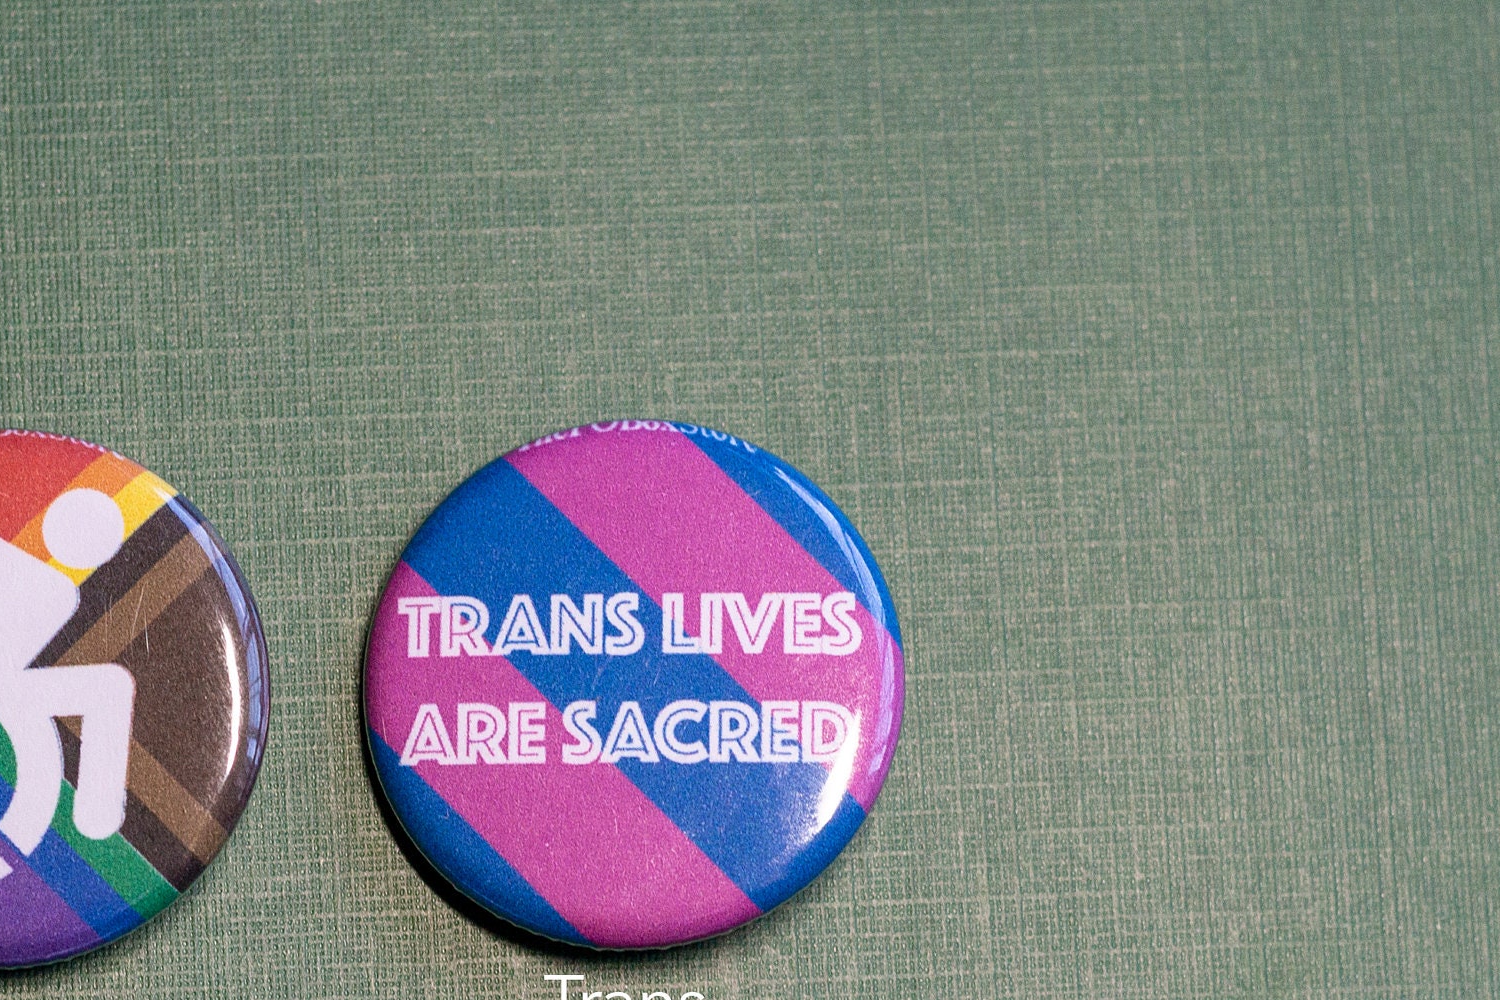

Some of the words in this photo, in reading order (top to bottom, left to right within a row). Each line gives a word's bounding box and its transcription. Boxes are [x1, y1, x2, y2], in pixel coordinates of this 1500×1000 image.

[397, 593, 645, 659] TRANS
[661, 591, 863, 656] LIVES
[399, 701, 548, 767] ARE
[561, 700, 860, 765] SACRED
